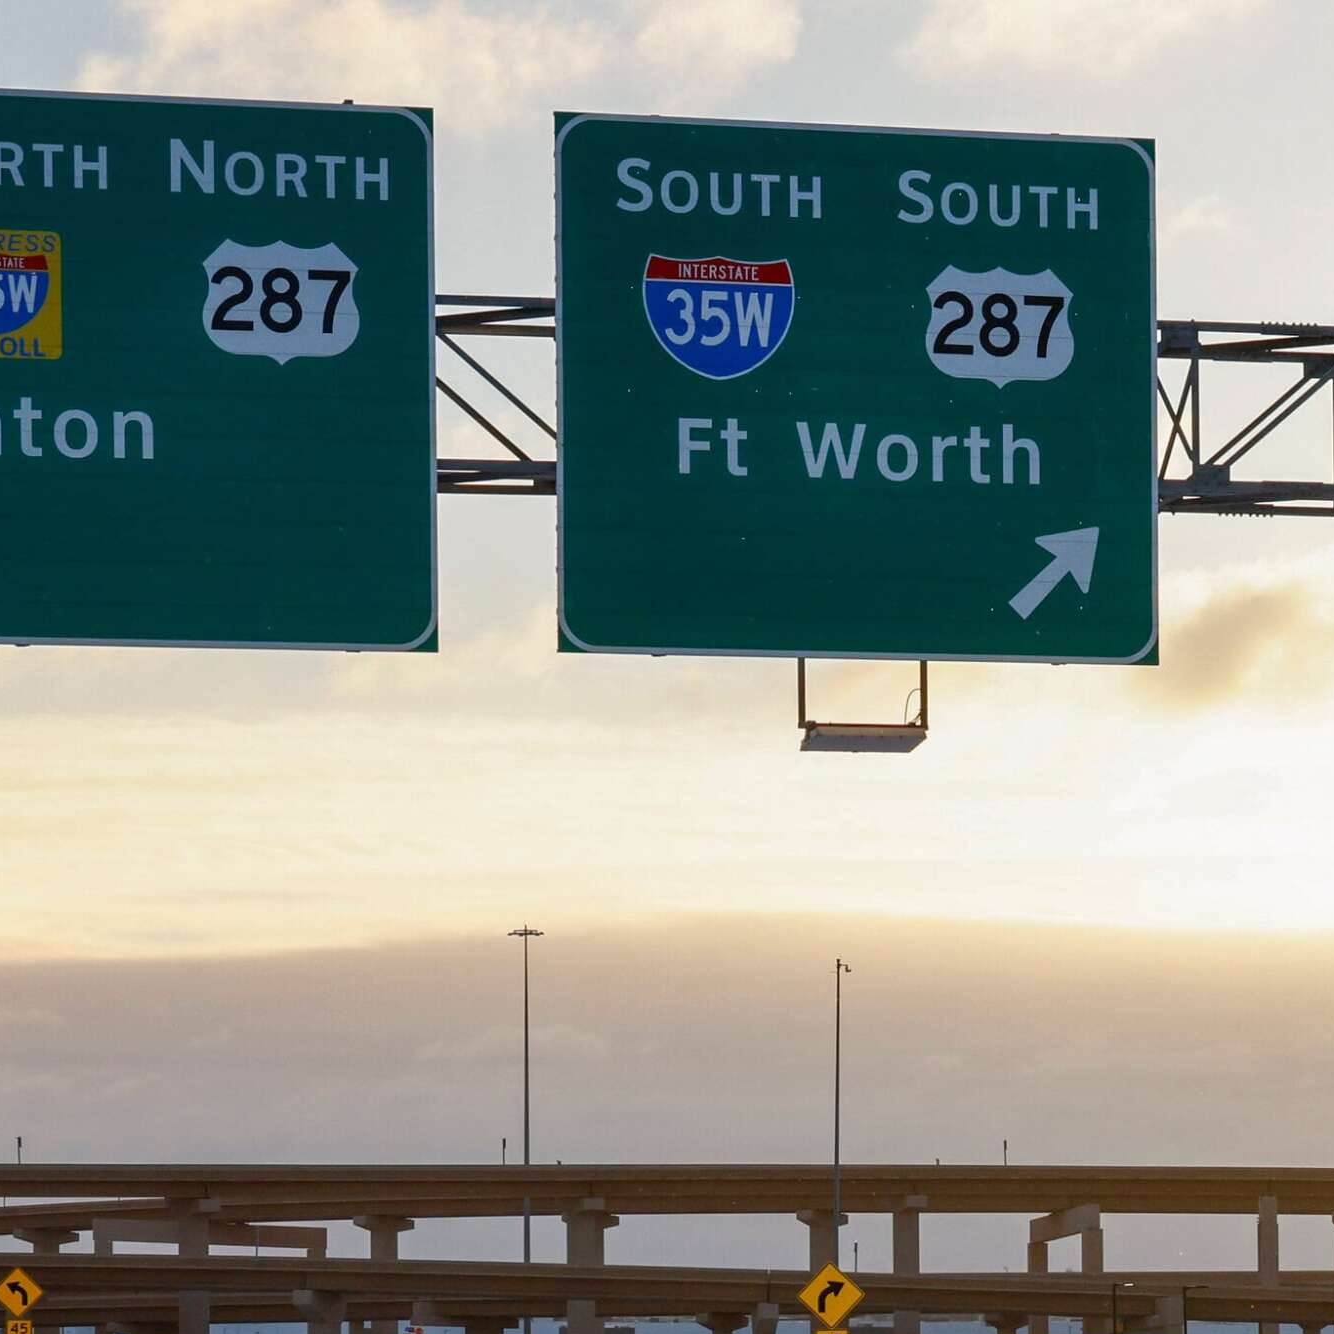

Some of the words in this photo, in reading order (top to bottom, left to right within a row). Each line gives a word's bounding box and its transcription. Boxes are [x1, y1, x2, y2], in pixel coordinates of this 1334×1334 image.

[169, 137, 389, 201] NORTH
[615, 157, 823, 219] SOUTH
[897, 169, 1099, 231] SOUTH
[210, 265, 352, 335] 287
[677, 262, 760, 282] INTERSTATE
[664, 288, 774, 348] 35W
[932, 290, 1065, 359] 287
[678, 417, 749, 477] Ft
[795, 421, 1041, 485] Worth
